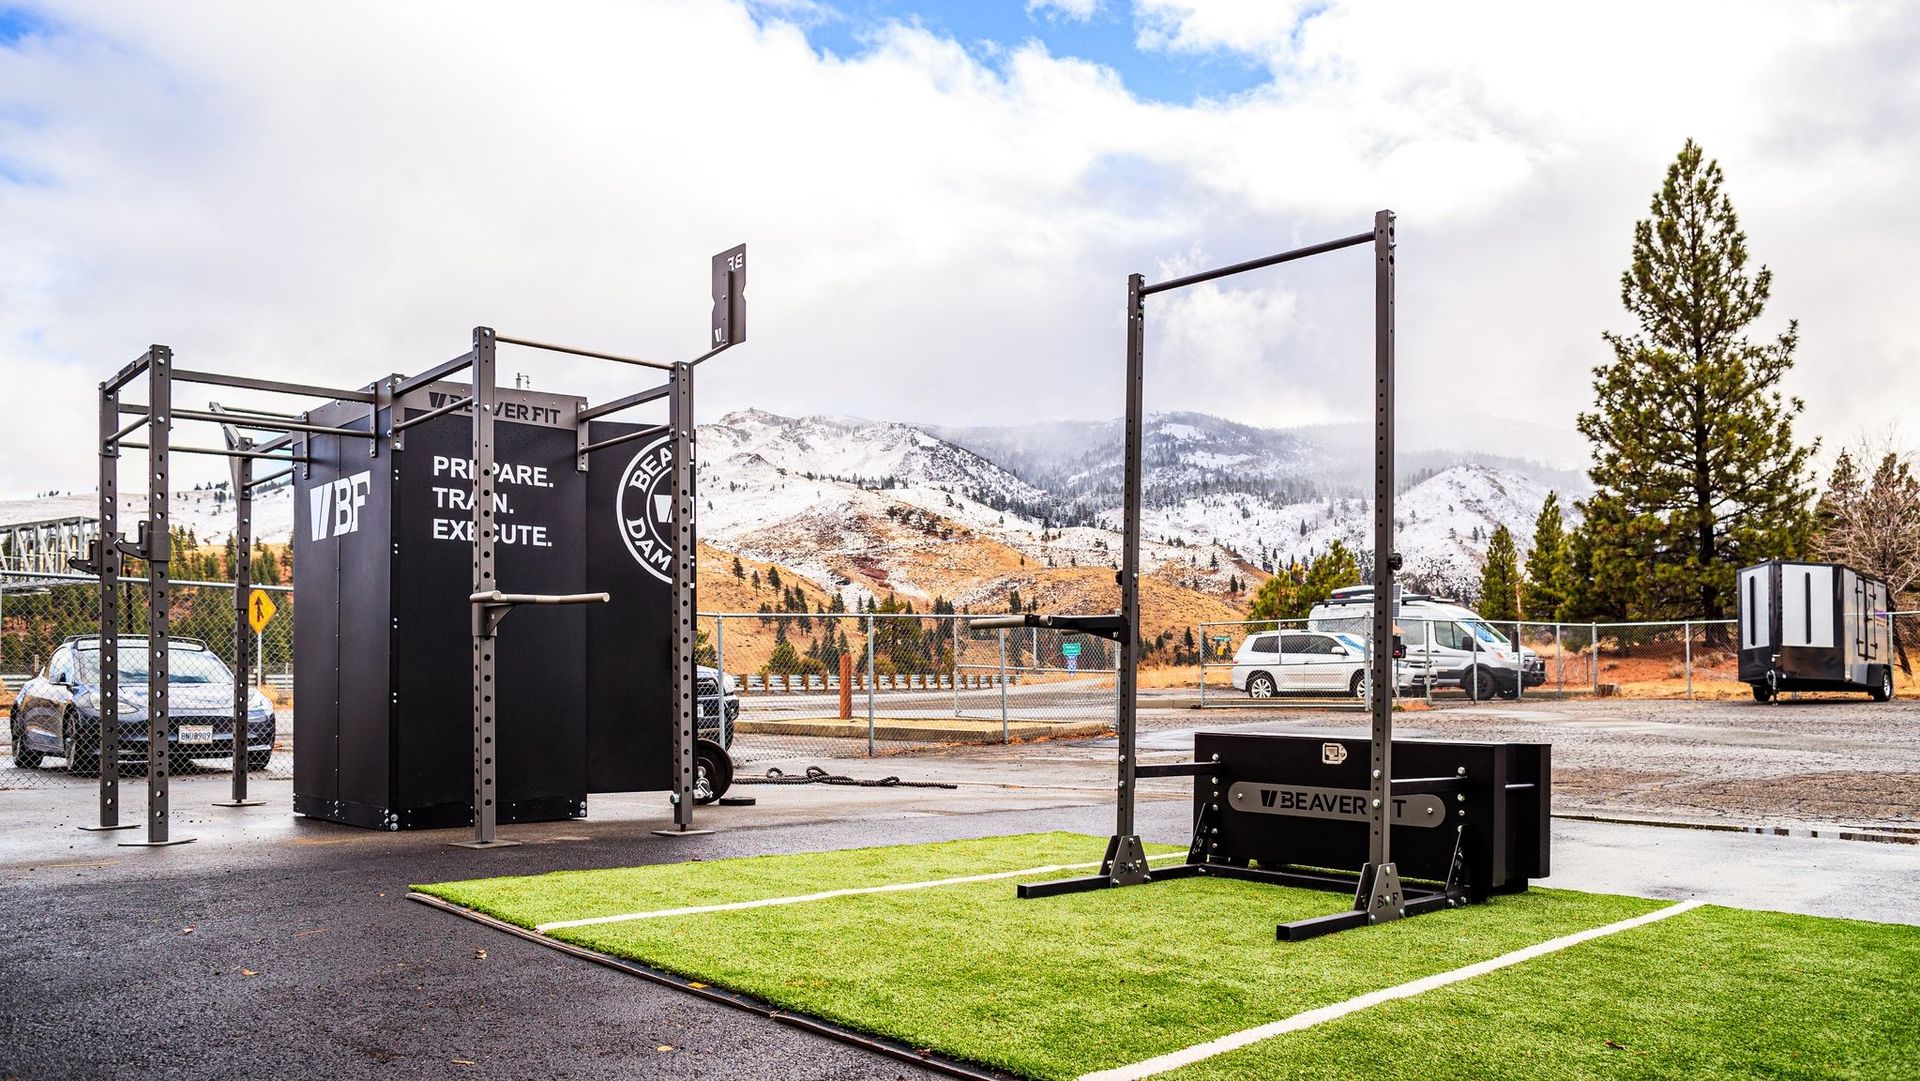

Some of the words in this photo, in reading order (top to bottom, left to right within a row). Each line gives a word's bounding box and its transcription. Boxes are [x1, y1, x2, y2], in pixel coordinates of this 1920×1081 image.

[531, 406, 561, 425] FIT
[433, 455, 554, 488] PRARE.
[432, 486, 514, 514] TRAN.
[1280, 791, 1367, 815] BEAVER
